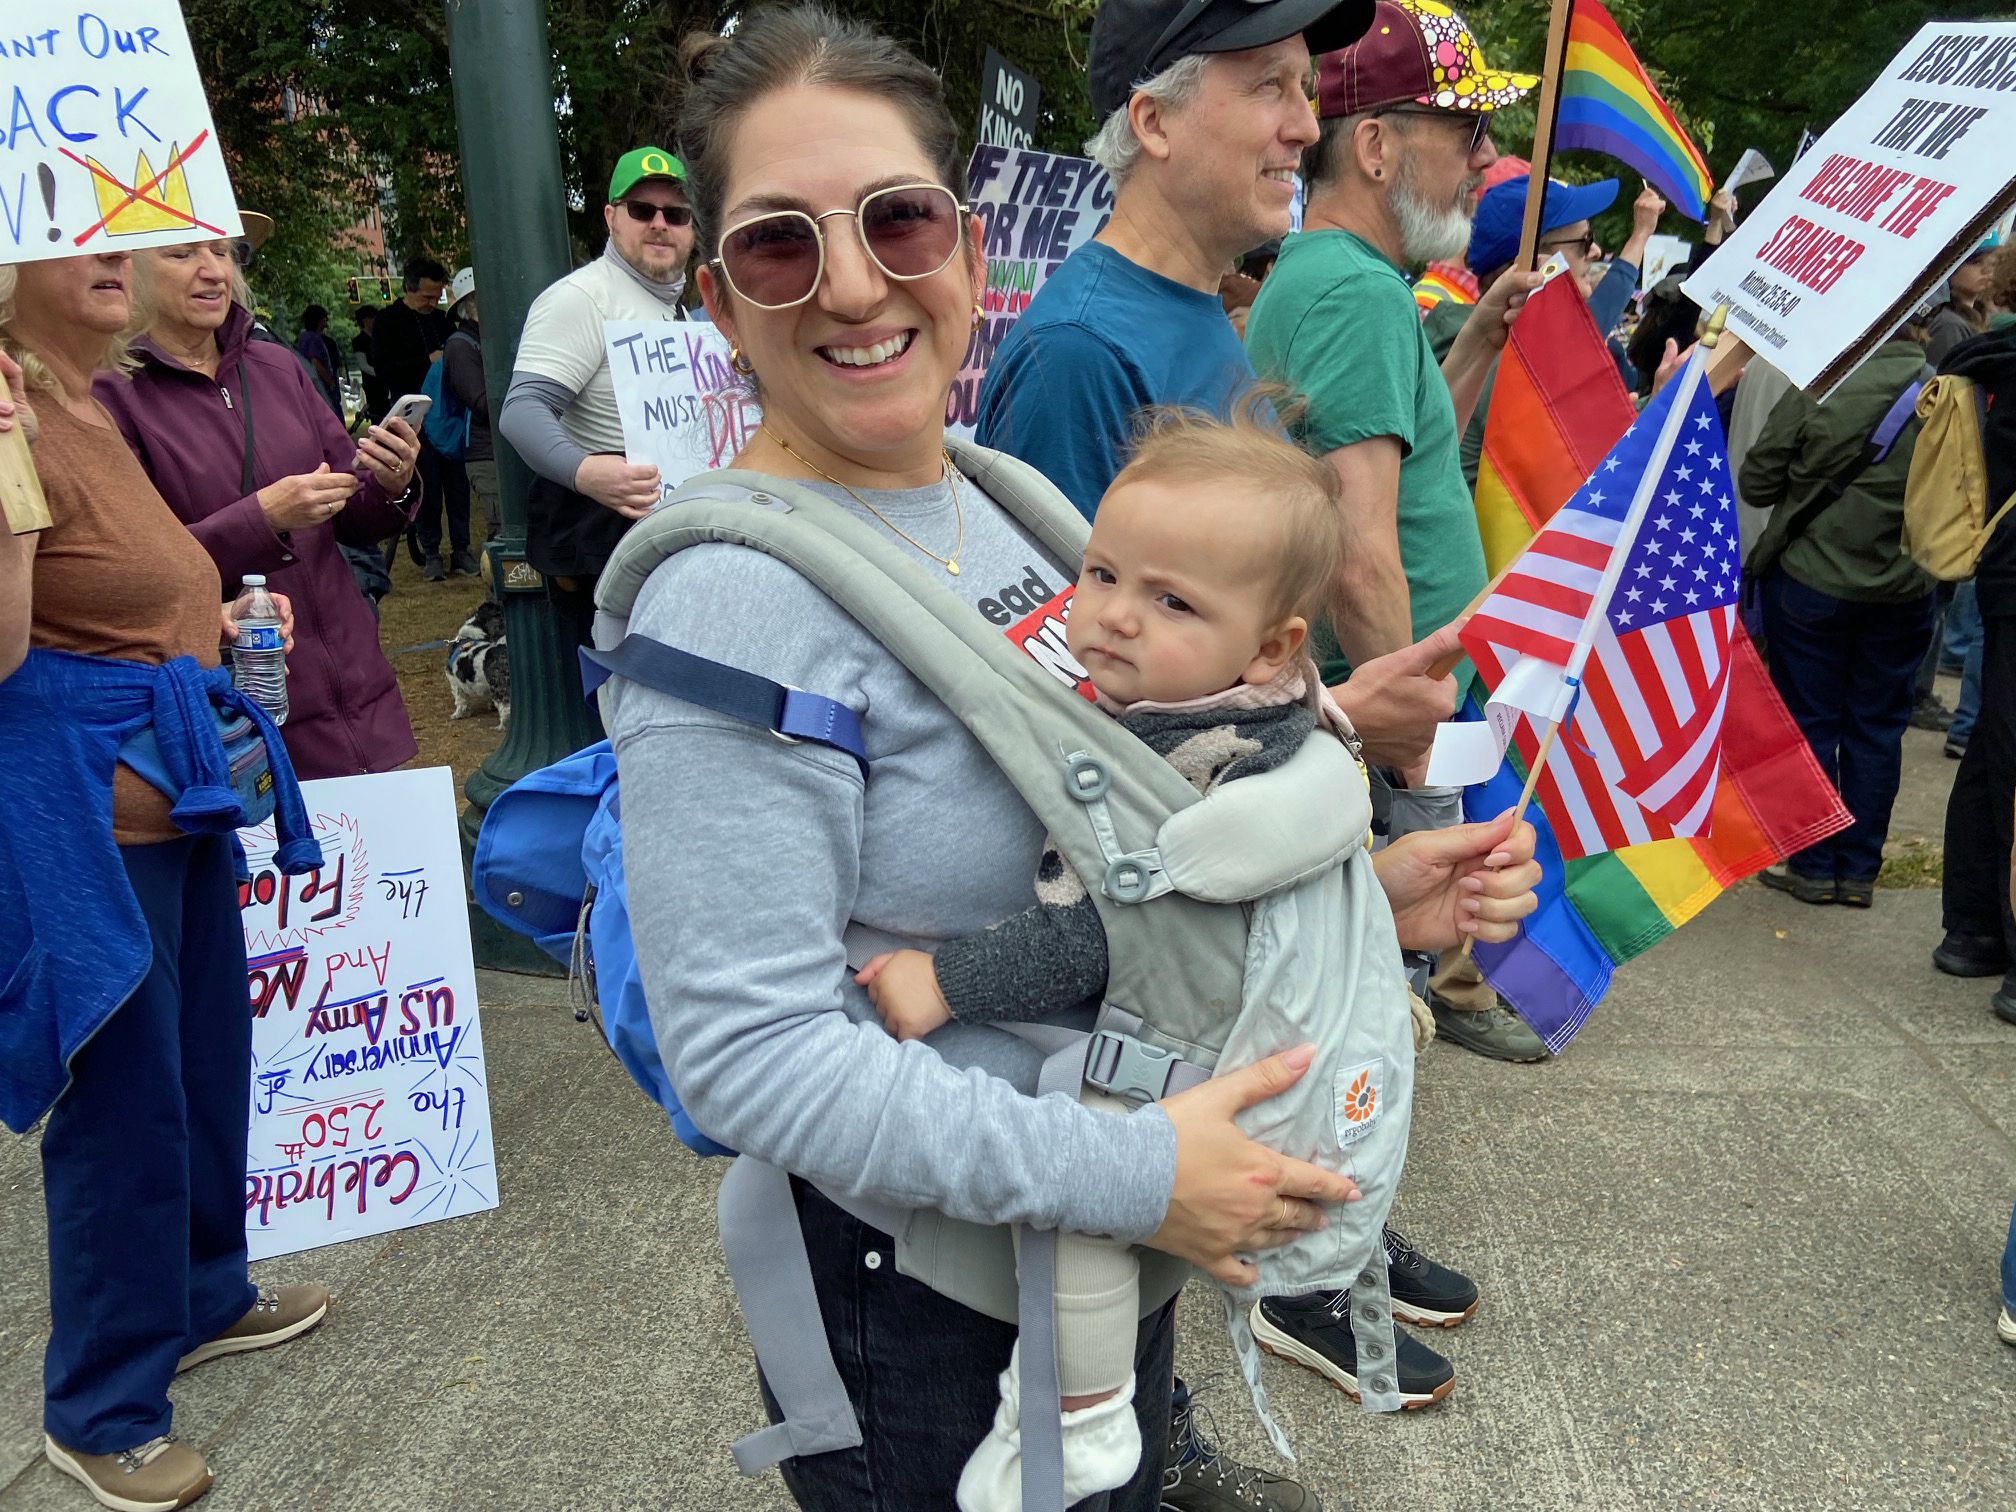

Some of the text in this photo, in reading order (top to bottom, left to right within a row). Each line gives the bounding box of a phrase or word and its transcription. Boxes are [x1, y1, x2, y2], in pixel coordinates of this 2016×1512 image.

[78, 13, 170, 59] OUR
[1897, 35, 1989, 85] JESUS
[0, 84, 162, 150] ACK
[996, 68, 1024, 116] NO
[1870, 98, 1989, 160] THAT WE
[968, 144, 1009, 199] IF
[1008, 151, 1103, 209] THEY
[1019, 207, 1080, 260] ME
[1878, 177, 1957, 239] THE
[1756, 215, 1865, 296] STRANGER
[612, 331, 739, 393] THE KIN
[644, 394, 698, 431] MUST
[977, 565, 1057, 626] ead
[377, 879, 429, 919] the
[326, 941, 391, 992] And
[304, 981, 389, 1045] Army
[257, 1026, 461, 1114] Anniversary of
[408, 1086, 466, 1131] the
[245, 1150, 420, 1226] Celebrate
